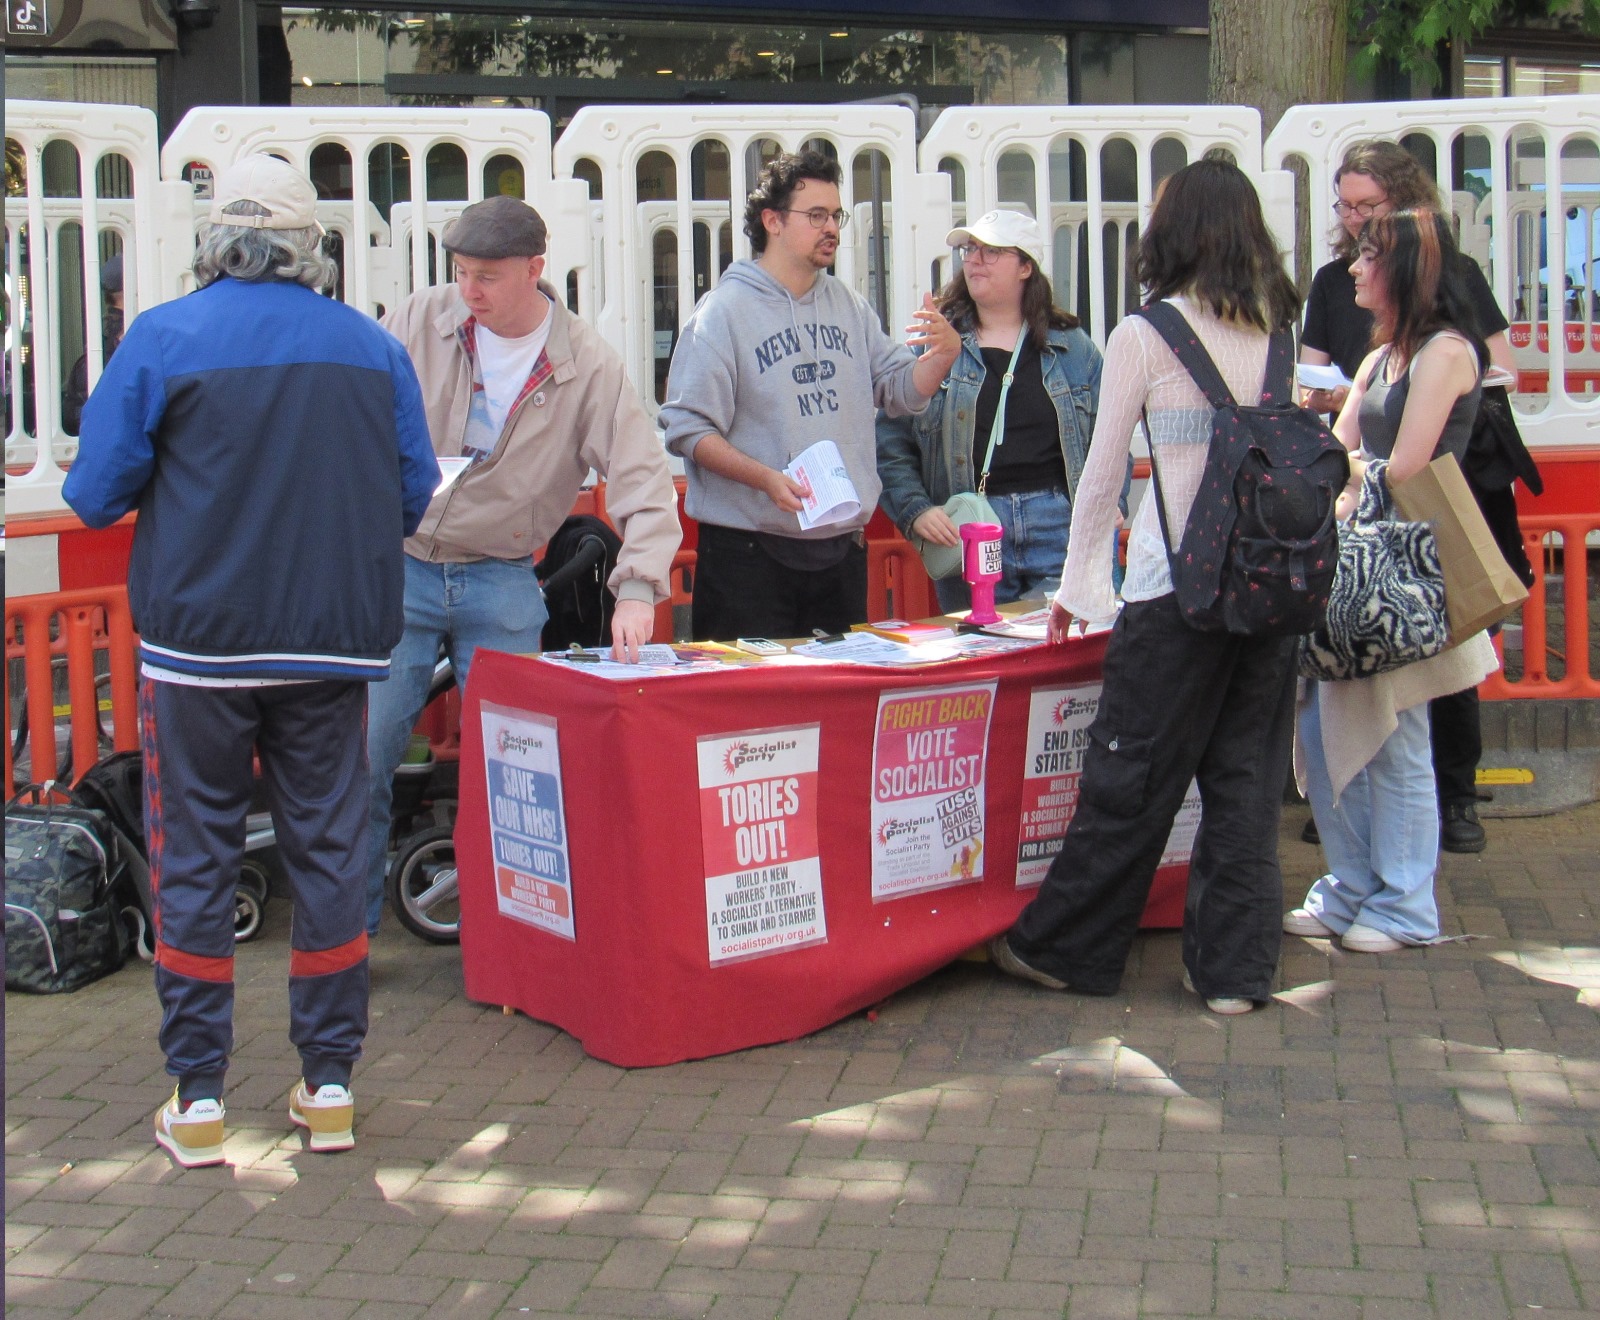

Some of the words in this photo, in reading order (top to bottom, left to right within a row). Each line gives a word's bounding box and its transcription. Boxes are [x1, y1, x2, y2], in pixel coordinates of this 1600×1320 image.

[193, 170, 214, 180] ALA
[755, 325, 801, 374] NEW
[804, 323, 853, 359] YORK
[797, 389, 839, 416] NYC
[985, 541, 1002, 553] TUS
[882, 700, 937, 731] FIGHT
[939, 693, 989, 723] BACK
[1068, 698, 1098, 709] Socia
[504, 730, 543, 748] Socialist
[739, 741, 796, 755] Socialist
[907, 727, 957, 762] VOTE
[1044, 731, 1068, 751] END
[1035, 751, 1072, 773] STATE
[503, 765, 537, 803] SAVE
[880, 755, 979, 799] SOCIALIST
[1050, 778, 1072, 792] BUILD
[718, 778, 799, 827] TORIES
[936, 787, 976, 817] TUSC
[1023, 812, 1028, 824] A
[1031, 806, 1070, 823] SOCIALIST
[495, 795, 521, 831] OUR
[522, 804, 557, 842] NHS!
[890, 816, 935, 829] Socialist
[941, 803, 979, 831] AGAINST
[735, 820, 788, 866] OUT!
[943, 818, 982, 847] CUTS
[1025, 825, 1035, 838] TO
[498, 837, 532, 869] TORIES
[533, 848, 559, 877] OUT!
[885, 845, 912, 856] Socialist
[913, 843, 931, 852] Party
[1022, 843, 1037, 857] FOR
[1039, 842, 1044, 855] A
[736, 872, 760, 889] BUILD
[762, 870, 768, 883] A
[770, 866, 789, 882] NEW
[879, 870, 949, 890] socialistparty.org.uk
[1020, 864, 1050, 876] socialis
[725, 886, 767, 907] WORKERS'
[770, 880, 796, 898] PARTY
[712, 912, 718, 925] A
[721, 903, 762, 924] SOCIALIST
[765, 892, 816, 915] ALTERNATIVE
[717, 926, 729, 940] TO
[731, 920, 759, 938] SUNAK
[761, 916, 776, 932] AND
[779, 907, 817, 928] STARMER
[721, 926, 816, 954] socialistparty.org.uk
